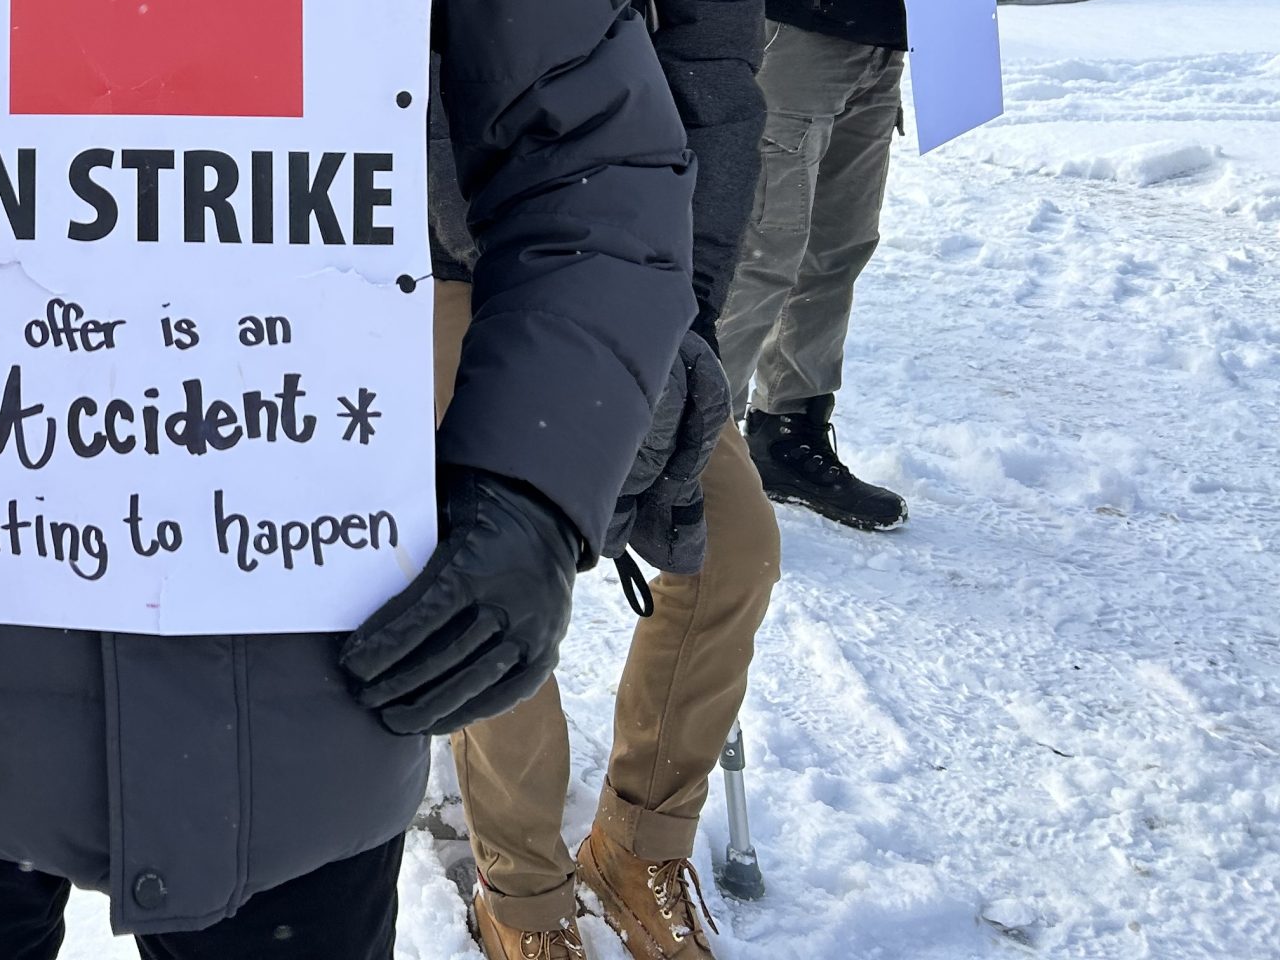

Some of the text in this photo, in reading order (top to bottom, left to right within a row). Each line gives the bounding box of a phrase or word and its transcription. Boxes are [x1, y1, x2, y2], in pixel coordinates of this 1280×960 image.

[67, 148, 394, 245] STRIKE
[24, 298, 127, 352] offer
[160, 302, 200, 350] is
[238, 315, 292, 346] an
[122, 493, 183, 557] to
[214, 489, 398, 572] happen
